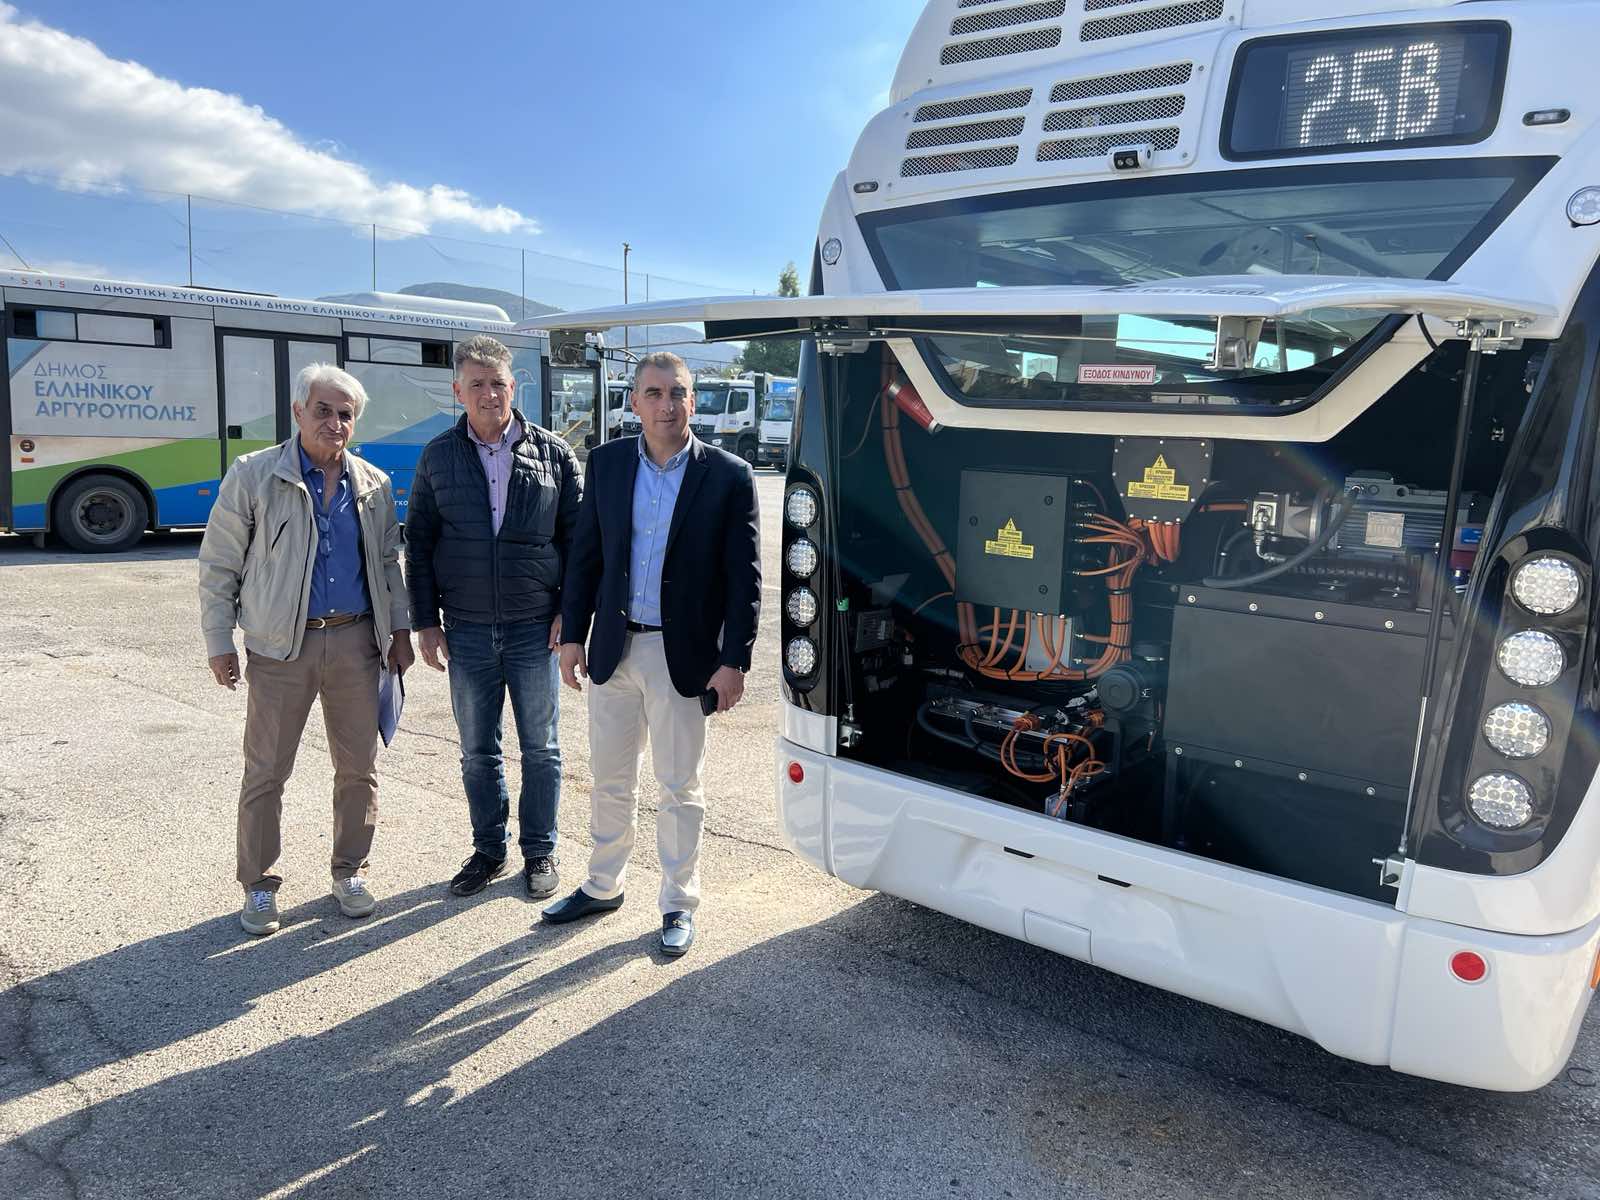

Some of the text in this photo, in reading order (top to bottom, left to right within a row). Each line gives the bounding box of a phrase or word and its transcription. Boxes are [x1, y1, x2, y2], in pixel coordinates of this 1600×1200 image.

[93, 283, 167, 298] ΔΗΜΟΤΙΚΗ
[172, 291, 262, 308] ΣΥΓΚΟΙΝΩΝΙΑ
[266, 302, 308, 312] ΔΗΜΟΥ
[312, 306, 376, 319] ΕΛΛΗΝΙΚΟΥ
[34, 361, 108, 380] ΔΗΜΟΣ
[1083, 369, 1152, 380] ΕΞΟΔΟΣ ΚΙΝΔΥΝΟΥ
[34, 380, 155, 401] ΕΛΛΗΝΙΚΟΥ
[35, 400, 197, 422] ΑΡΓΥΡΟΥΠΟΛΗΣ
